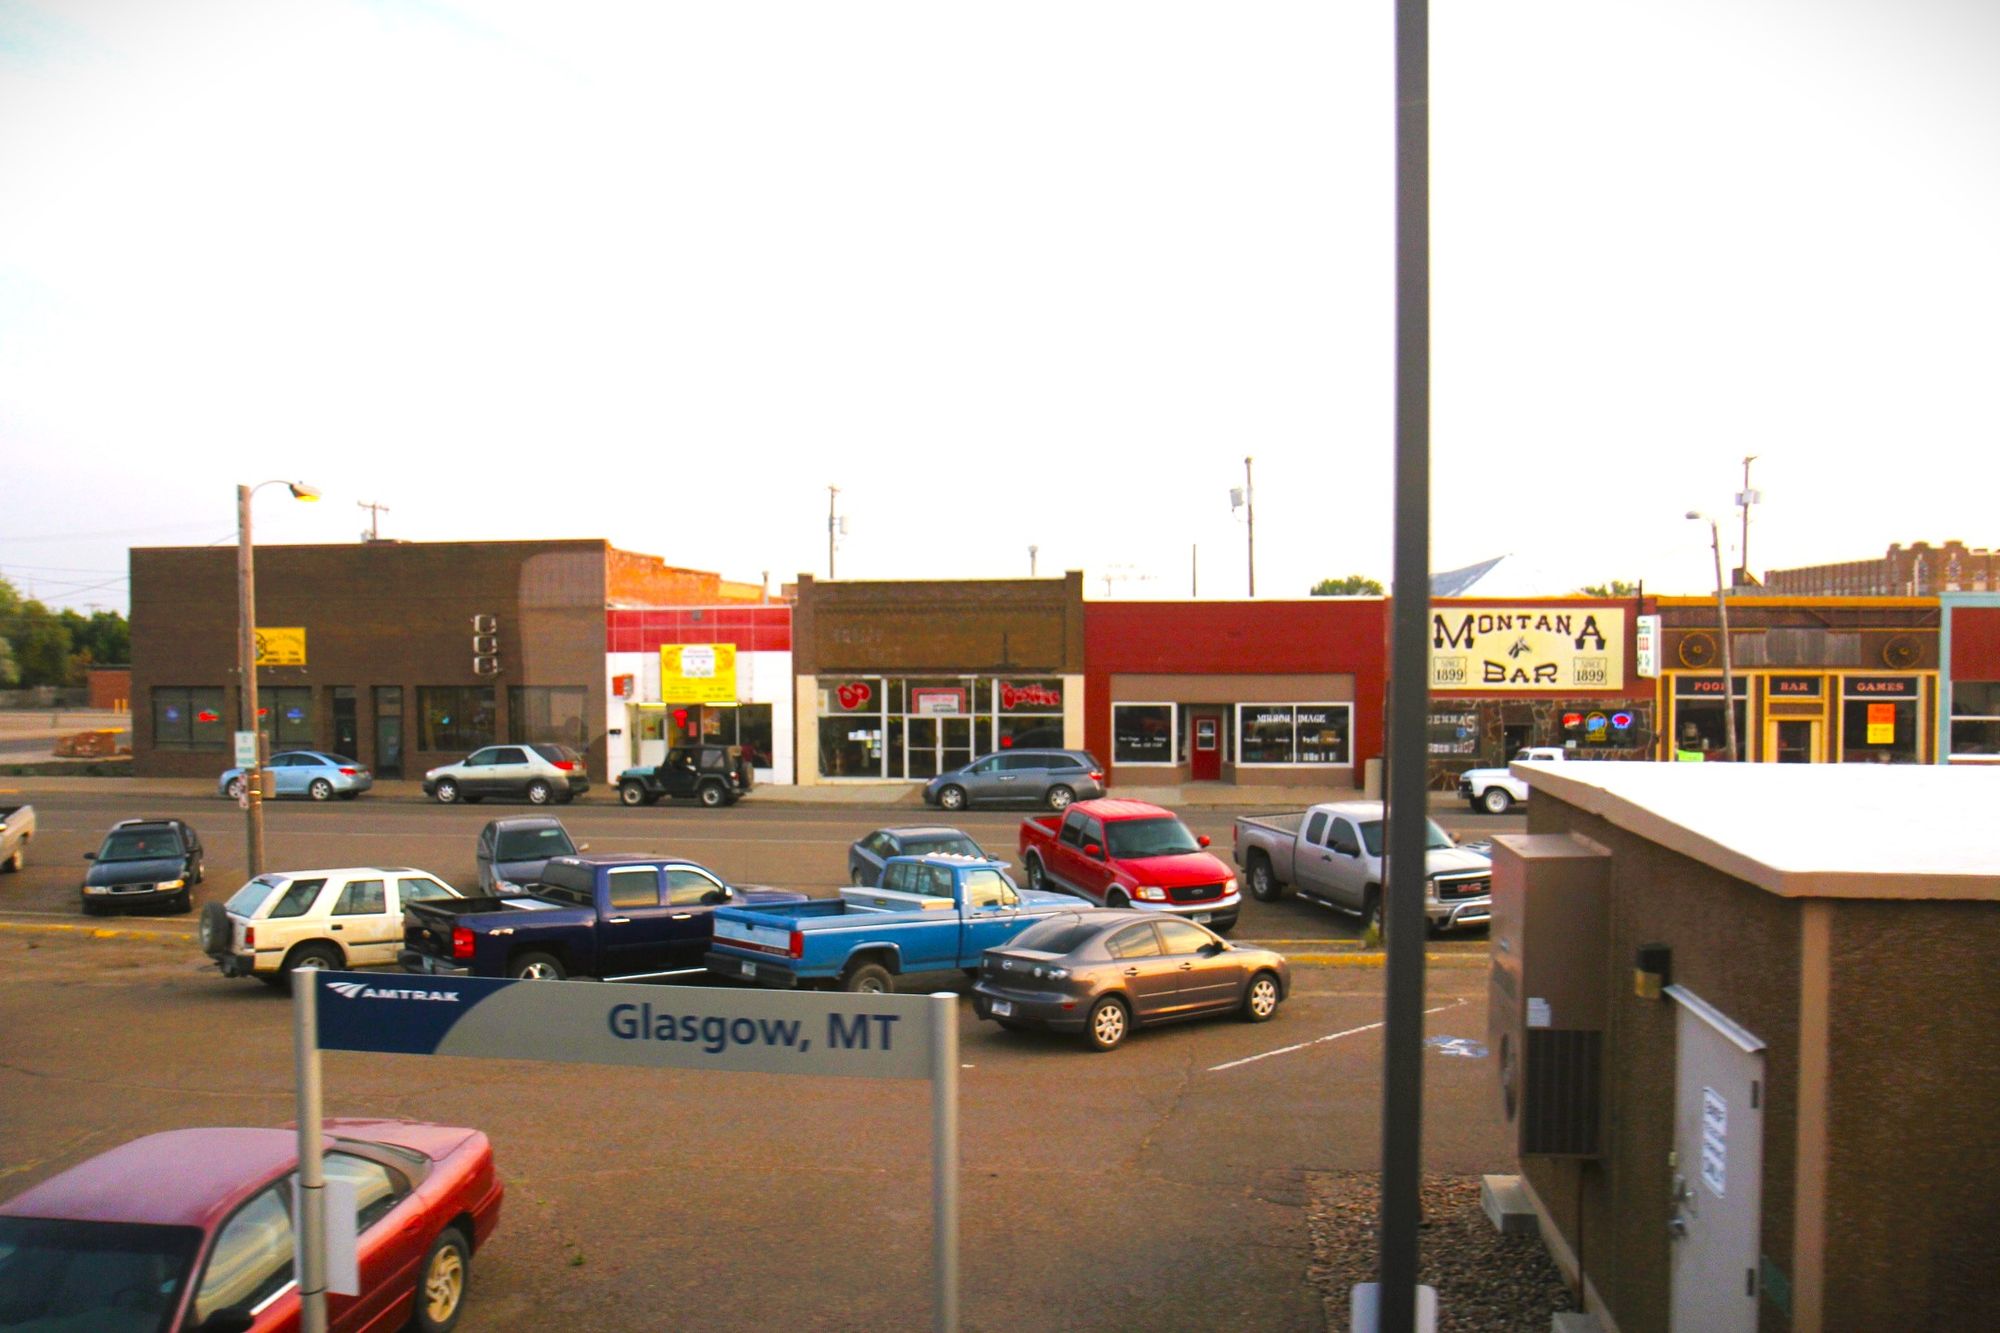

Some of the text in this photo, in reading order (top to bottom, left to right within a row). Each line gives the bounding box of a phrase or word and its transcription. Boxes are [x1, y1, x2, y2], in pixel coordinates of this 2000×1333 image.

[1433, 614, 1606, 650] MONTANA
[1437, 669, 1464, 681] 1899
[1483, 660, 1557, 683] BAR
[1577, 670, 1604, 682] 1899
[1780, 682, 1808, 691] BAR
[1857, 682, 1904, 692] GAMES
[1257, 714, 1326, 723] MIRROR IMAGE
[361, 988, 460, 1001] AMTRAK
[608, 1003, 900, 1053] Glasgow, MT
